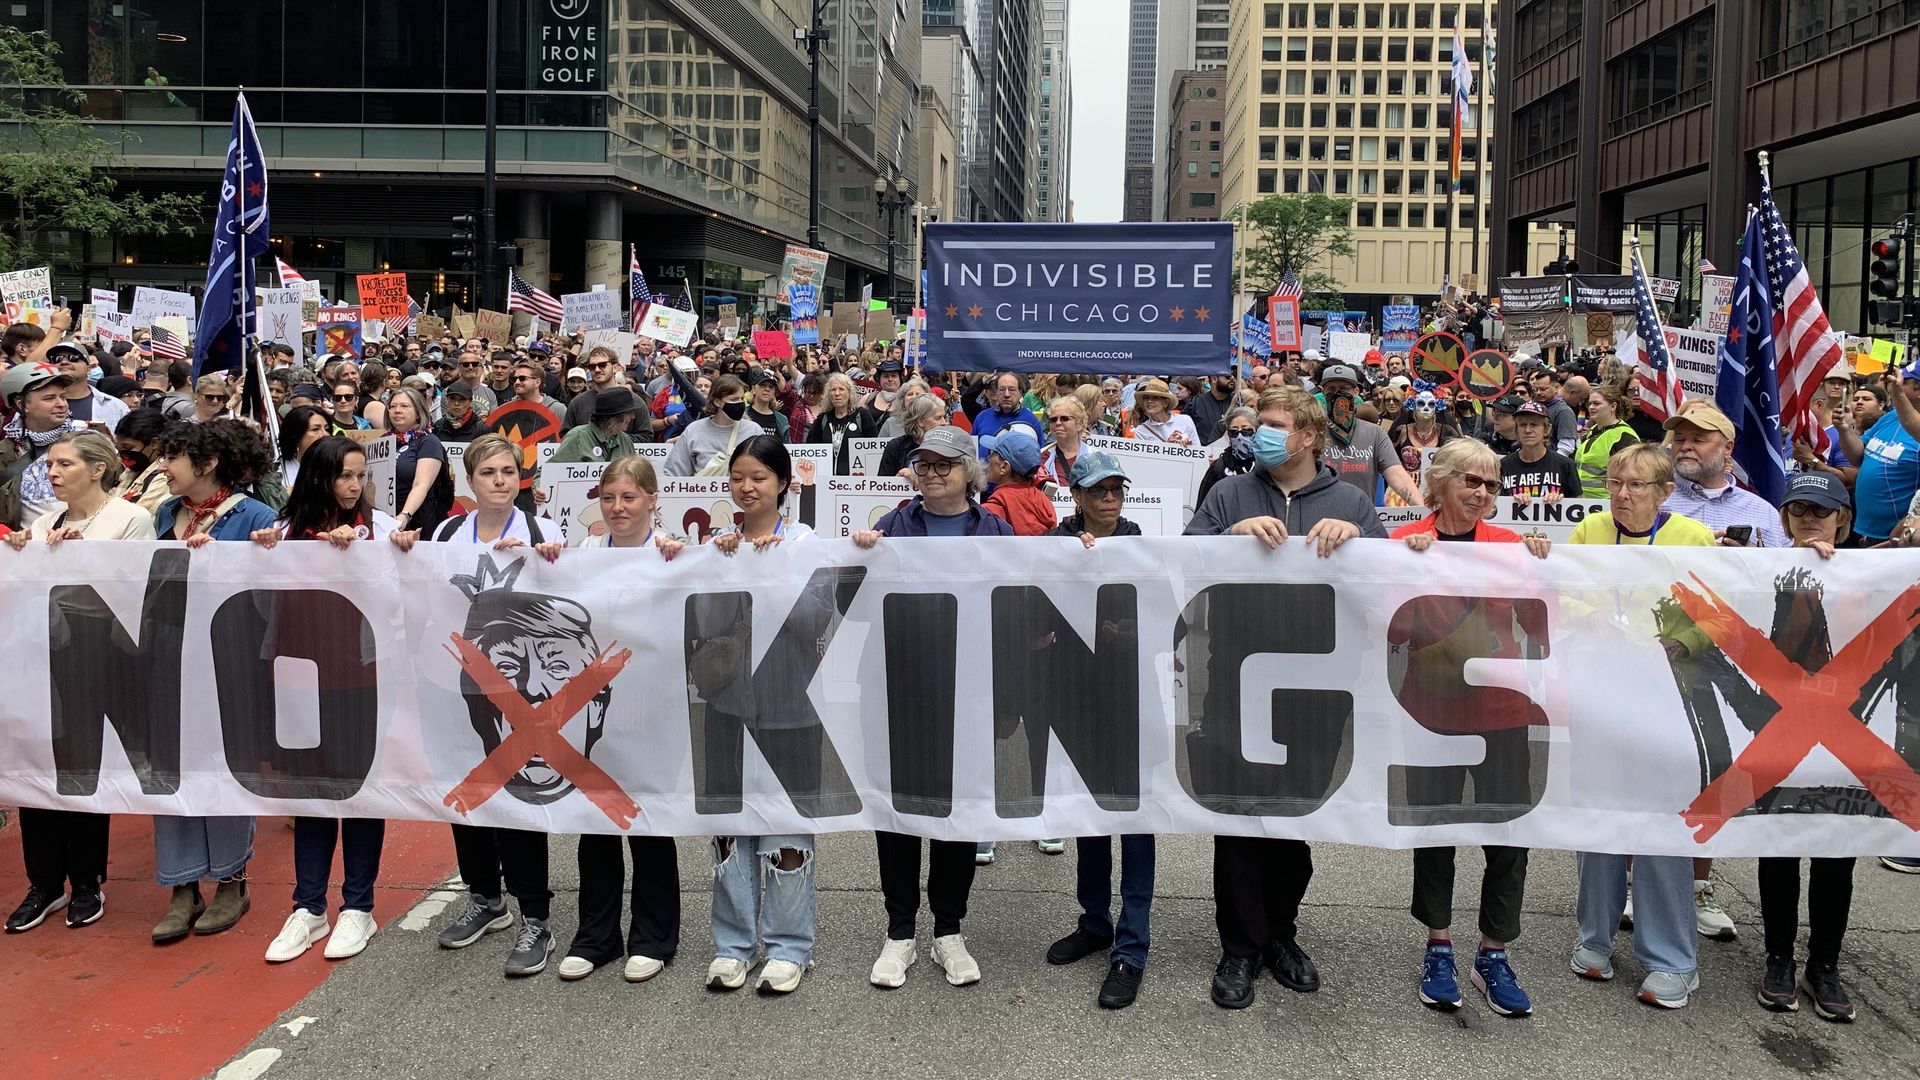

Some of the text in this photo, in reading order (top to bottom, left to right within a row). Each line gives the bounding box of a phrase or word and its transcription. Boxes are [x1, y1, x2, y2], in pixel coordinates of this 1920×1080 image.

[543, 26, 596, 40] FIVE
[542, 46, 596, 60] IRON
[542, 67, 596, 83] GOLF
[785, 247, 827, 260] REMEMBER
[0, 267, 48, 283] THE ONLY
[658, 265, 687, 278] 145
[943, 263, 1213, 288] INDIVISIBLE
[2, 277, 47, 292] KINGS
[361, 277, 390, 291] PROTECT
[1663, 279, 1680, 289] NATO
[3, 287, 49, 302] WE NEED ARE
[376, 288, 403, 298] PROCESS
[1577, 287, 1636, 297] TRUMP $UCK$
[1661, 286, 1676, 296] WAR
[267, 292, 300, 305] NO KINGS
[363, 297, 377, 306] ICE
[379, 297, 390, 305] OUT
[392, 296, 398, 304] OF
[1610, 297, 1631, 305] DICK
[380, 305, 402, 316] CITY!
[576, 303, 605, 313] AMERICA
[995, 302, 1160, 323] CHICAGO
[318, 312, 358, 323] NO KINGS
[481, 311, 503, 326] NO
[477, 327, 506, 343] KINGS
[1248, 324, 1262, 333] RISE
[1679, 335, 1716, 355] KINGS
[1018, 350, 1133, 360] INDIVISIBLECHICAGO.COM
[1675, 358, 1717, 375] DICTATORS
[1680, 379, 1715, 396] ASCISTS
[367, 440, 390, 461] KINGS
[854, 441, 877, 450] OUR
[1086, 438, 1206, 459] OUR RESISTER HEROES
[566, 466, 590, 479] Tool
[828, 480, 910, 492] Sec. of Potions
[1503, 471, 1562, 489] WE ARE ALL
[664, 482, 675, 493] of
[679, 482, 707, 493] Hate
[1123, 492, 1162, 504] ineless
[1378, 511, 1422, 522] Cruelty
[48, 548, 1550, 827] NO KINGS
